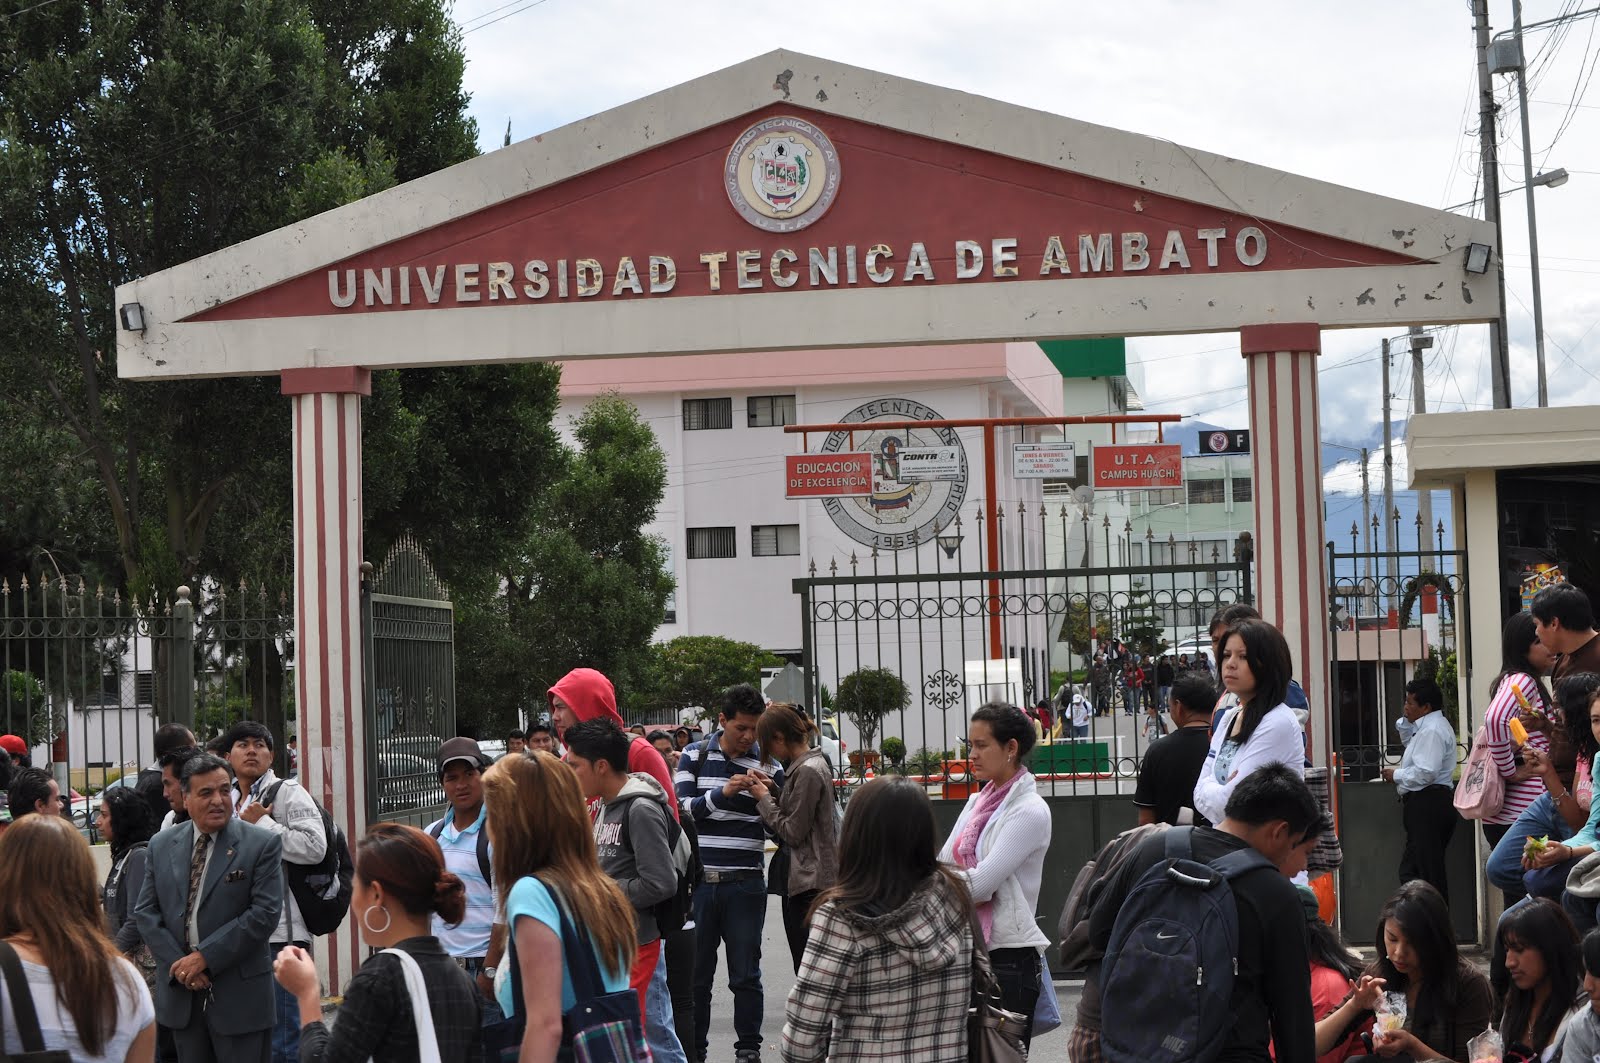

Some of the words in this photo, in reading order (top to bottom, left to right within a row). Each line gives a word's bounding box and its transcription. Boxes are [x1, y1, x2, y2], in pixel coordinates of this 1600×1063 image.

[757, 119, 813, 134] TECNICA
[328, 255, 677, 308] UNIVERSIDAD
[700, 241, 935, 290] TECNICA
[955, 238, 1019, 279] DE
[1039, 226, 1268, 275] AMBATO
[1114, 453, 1160, 465] U.T.A.
[796, 461, 861, 474] EDUCACION
[1100, 469, 1138, 480] CAMPUS
[1141, 468, 1175, 478] HUACHI
[790, 478, 803, 488] DE
[806, 477, 867, 488] EXCELENCIA
[1160, 1034, 1188, 1054] NIKE
